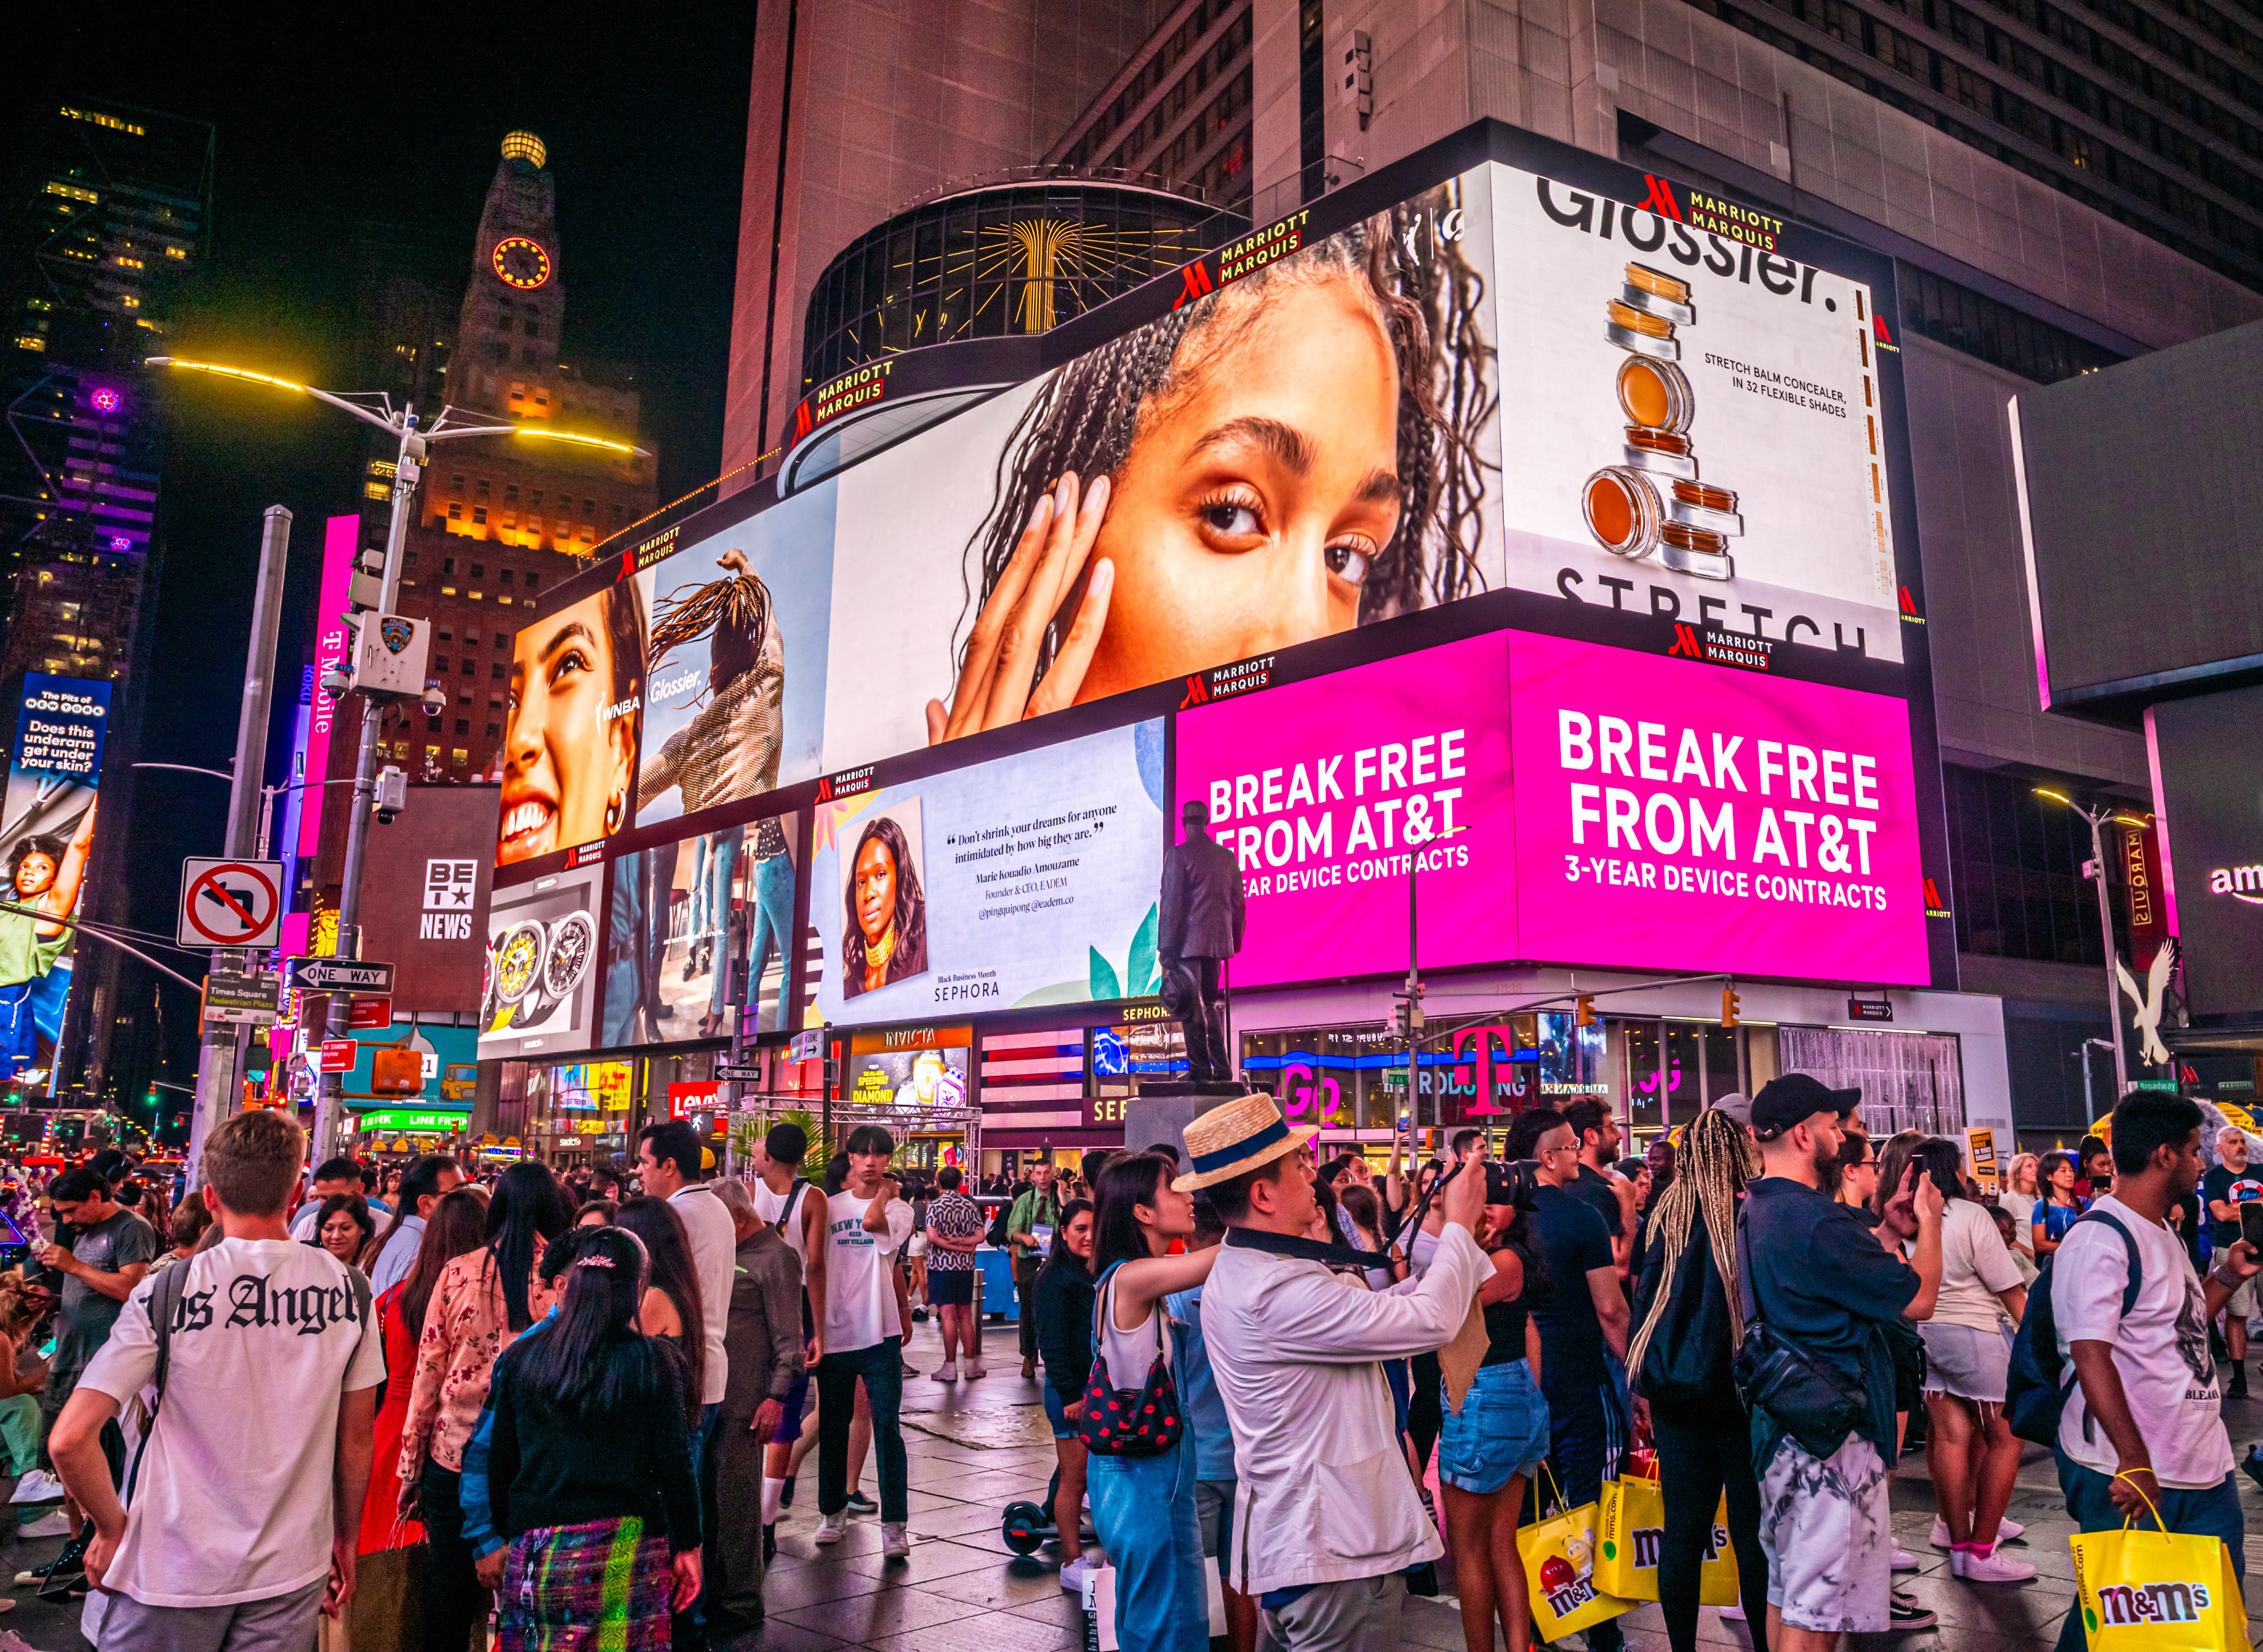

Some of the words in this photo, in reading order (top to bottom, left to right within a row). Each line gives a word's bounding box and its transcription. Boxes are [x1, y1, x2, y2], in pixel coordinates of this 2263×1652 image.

[1690, 192, 1783, 234] MARRIOTT
[1220, 210, 1310, 264] MARRIOTT
[1691, 212, 1775, 251] MARQUIS
[1220, 235, 1300, 283] MARQUIS
[1875, 341, 1900, 353] ARRIOTT
[818, 362, 893, 403] MARRIOTT
[1705, 353, 1750, 375] STRETCH
[1754, 367, 1780, 384] BALM
[1784, 376, 1847, 405] CONCEALER,
[816, 382, 883, 422] MARQUIS
[1733, 376, 1743, 389] IN
[1746, 381, 1758, 393] 32
[1761, 385, 1806, 407] FLEXIBLE
[1809, 398, 1847, 418] SHADES
[639, 526, 680, 554] MARRIOTT
[639, 543, 674, 567] MARQUIS
[1900, 614, 1926, 625] ARRIOTT
[1706, 631, 1773, 654] MARRIOTT
[1707, 646, 1767, 668] MARQUIS
[1214, 657, 1275, 682] MARRIOTT
[42, 691, 59, 700] The
[61, 694, 79, 702] Pits
[650, 669, 702, 703] Glossier.
[1214, 673, 1267, 697] MARQUIS
[25, 698, 59, 711] NEW
[61, 703, 105, 716] YORK
[603, 696, 640, 721] WNBA
[30, 720, 66, 734] Does
[68, 725, 94, 738] this
[24, 734, 96, 750] underarm
[24, 746, 49, 757] get
[51, 748, 93, 760] under
[21, 757, 54, 768] your
[56, 759, 93, 772] skin?
[1558, 708, 1748, 792] BREAK
[1757, 739, 1879, 810] FREE
[836, 766, 874, 784] MARRIOTT
[1210, 754, 1345, 824] BREAK
[1354, 729, 1466, 797] FREE
[835, 779, 868, 795] MARQUIS
[982, 825, 1010, 843] shrink
[1011, 822, 1031, 838] your
[1032, 816, 1066, 830] dreams
[1068, 811, 1081, 824] for
[1082, 805, 1117, 820] anyone
[1345, 787, 1462, 855] AT&T
[1570, 782, 1736, 861] FROM
[1753, 808, 1877, 875] AT&T
[578, 851, 601, 863] MARQUIS
[579, 841, 605, 854] MARRIOTT
[955, 843, 1004, 864] intimidated
[1005, 842, 1016, 856] by
[1017, 838, 1036, 853] how
[1038, 834, 1052, 849] big
[1053, 830, 1073, 845] they
[975, 873, 997, 884] Marie
[999, 866, 1031, 880] Kouadio
[1033, 858, 1079, 874] Amouzame
[1276, 865, 1341, 893] DEVICE
[1347, 845, 1469, 883] CONTRACTS
[537, 879, 556, 889] swatch
[986, 888, 1013, 900] Founder
[1014, 885, 1021, 894] &
[1022, 882, 1039, 894] CEO,
[1040, 877, 1067, 890] EADEM
[1565, 855, 1657, 889] 3-YEAR
[1664, 868, 1749, 897] DEVICE
[1755, 875, 1887, 910] CONTRACTS
[979, 903, 1030, 920] @pingquipong
[1031, 896, 1074, 912] @eadem.co
[1925, 909, 1951, 918] ARRIOTT
[420, 914, 472, 939] NEWS
[308, 968, 336, 980] ONE
[351, 970, 380, 983] WAY
[938, 975, 952, 983] Black
[978, 970, 996, 979] Month
[209, 996, 251, 1006] Pedestrian
[211, 987, 235, 996] Times
[237, 989, 267, 999] Square
[935, 982, 999, 1002] SEPHORA
[1124, 1006, 1171, 1021] SEPHOR
[524, 1040, 542, 1048] swatch
[808, 1033, 818, 1043] ZONE
[884, 1028, 935, 1047] INVICTA
[858, 1075, 889, 1086] SPEEDWAY
[1454, 1025, 1512, 1115] T
[853, 1089, 893, 1103] DIAMOND
[2141, 1082, 2175, 1091] Broadway
[410, 1116, 435, 1125] LINE
[1975, 1153, 1991, 1161] SQUARE
[831, 1219, 853, 1235] NEW
[225, 1273, 359, 1336] Angel
[1609, 1494, 1617, 1539] mms.com
[2077, 1545, 2089, 1605] mms.com
[2099, 1584, 2209, 1624] m&m's
